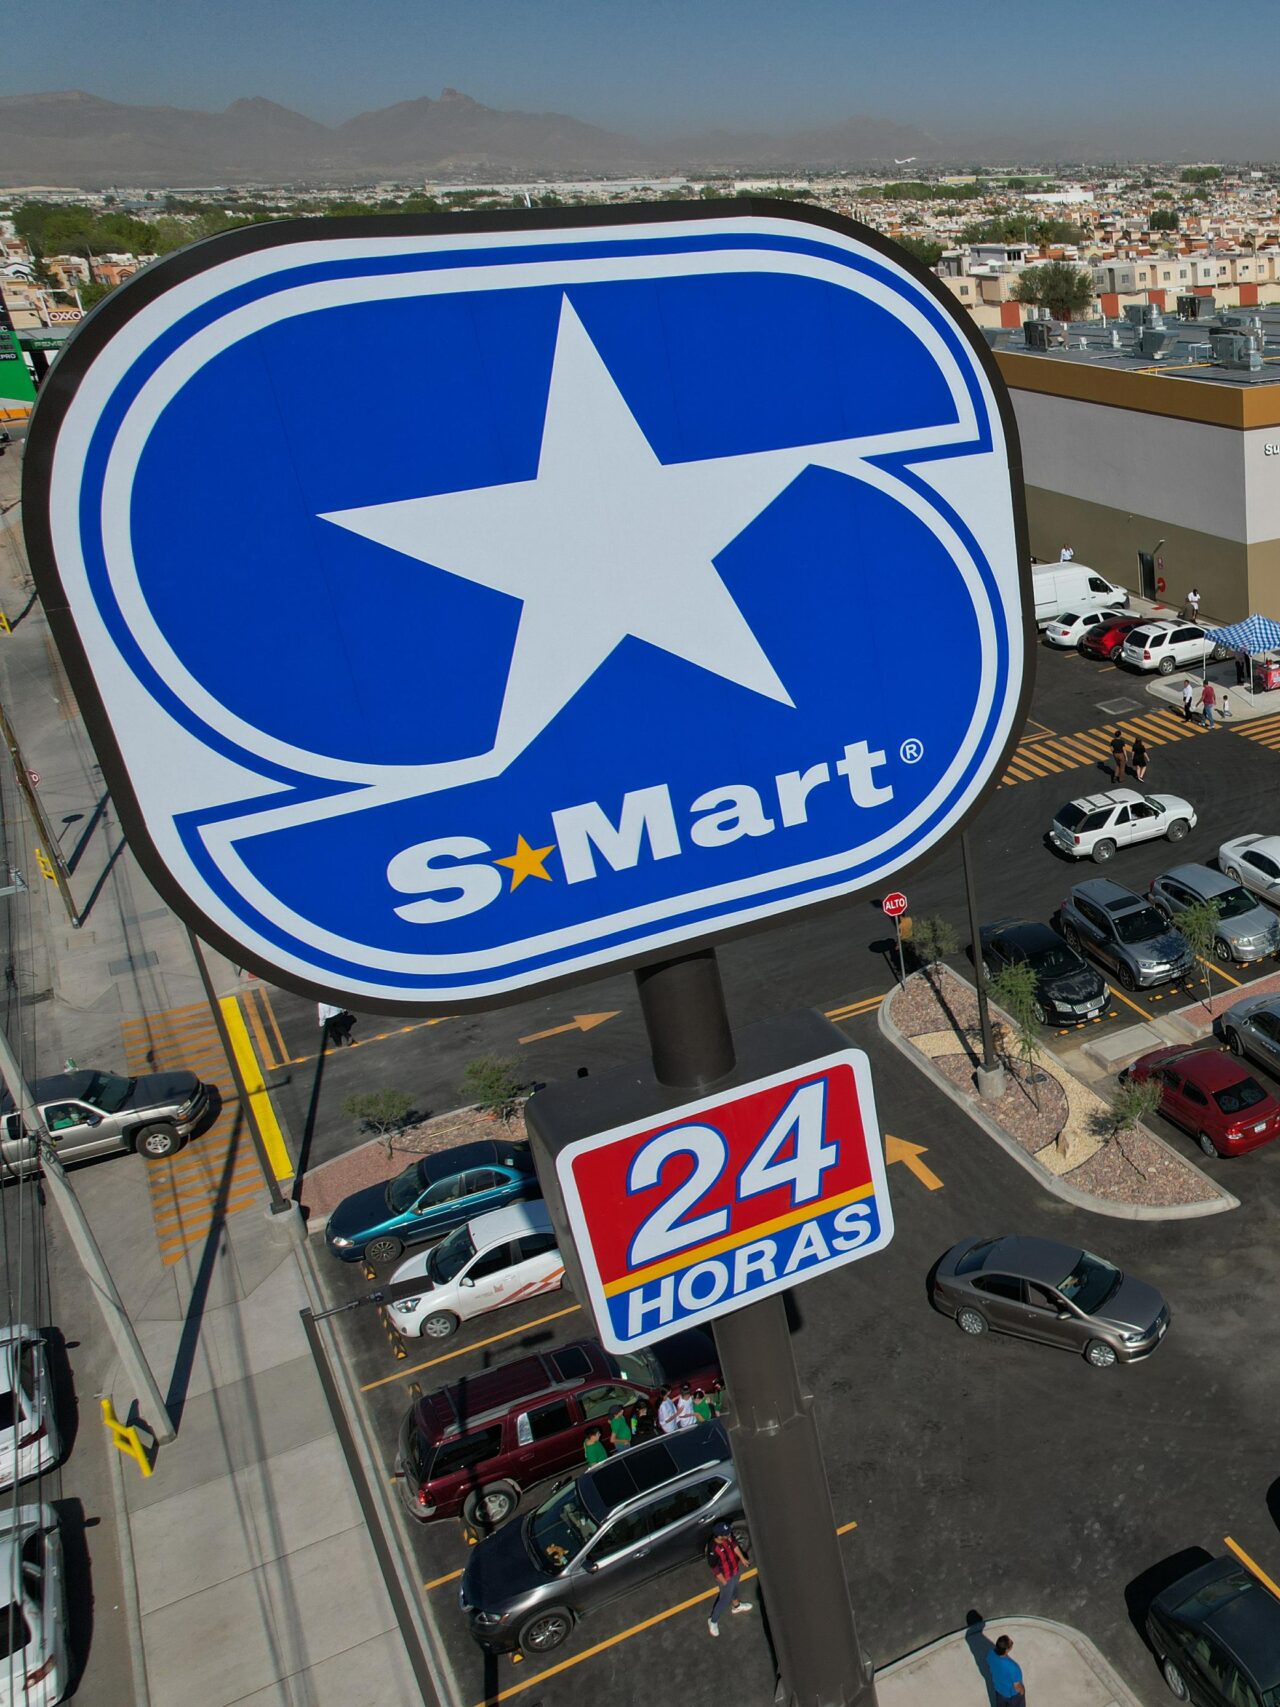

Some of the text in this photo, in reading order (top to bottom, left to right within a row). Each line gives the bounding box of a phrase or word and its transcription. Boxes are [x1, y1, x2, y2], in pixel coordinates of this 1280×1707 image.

[50, 311, 82, 321] OXXO
[885, 898, 905, 910] ALTO
[626, 1076, 841, 1271] 24
[627, 1203, 873, 1338] HORAS
